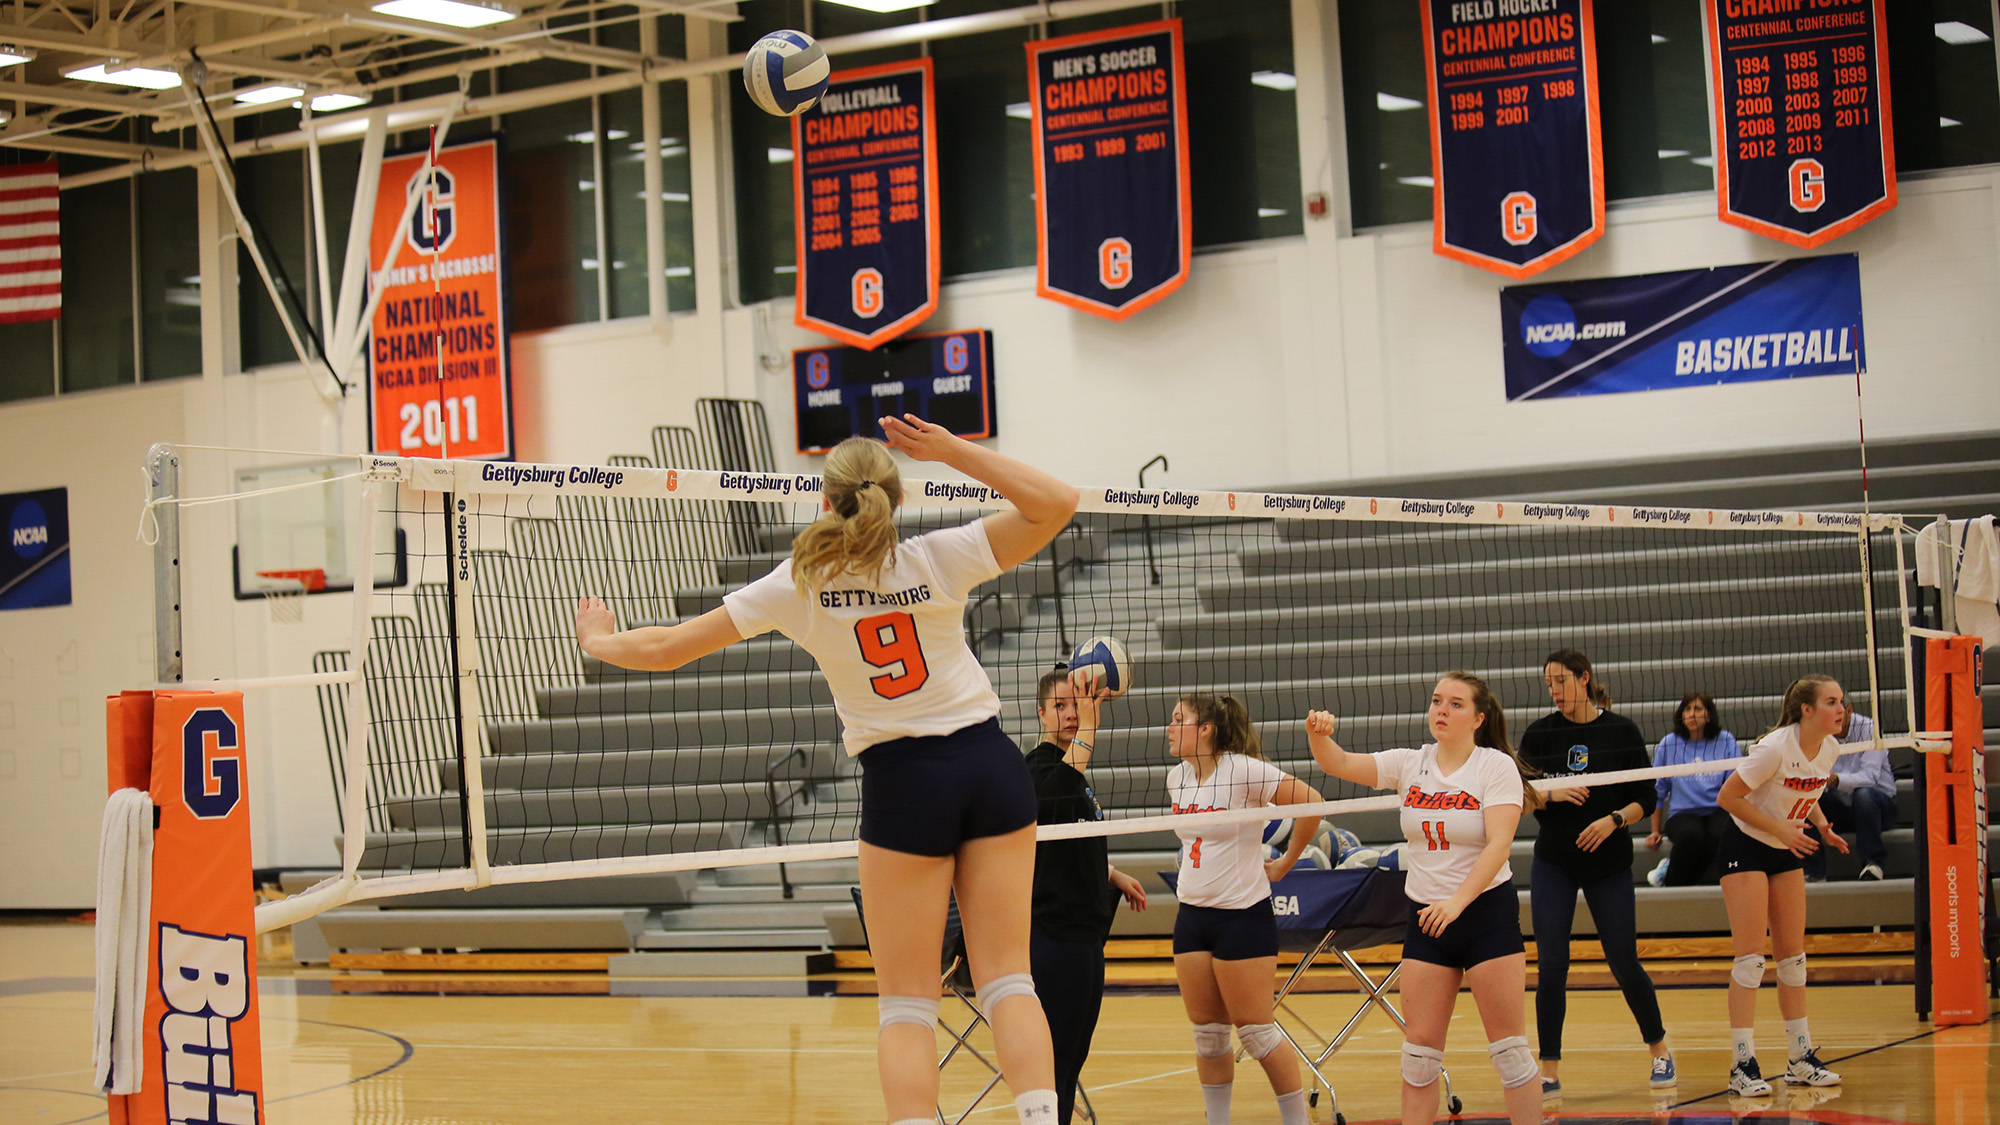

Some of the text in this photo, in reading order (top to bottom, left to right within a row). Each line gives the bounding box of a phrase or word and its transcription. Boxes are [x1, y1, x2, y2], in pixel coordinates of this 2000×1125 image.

[1451, 0, 1494, 23] FIELD
[1725, 0, 1863, 18] CHAMP
[1441, 13, 1574, 56] CHAMPIONS
[1727, 11, 1866, 40] CENTENNIAL CONFERENCE
[1053, 46, 1157, 79] MEN'S SOCCER
[1443, 46, 1576, 76] CENTENNIAL CONFERENCE
[1735, 45, 1866, 75] 1994 1995 1996
[1045, 68, 1167, 110] CHAMPIONS
[1450, 79, 1575, 111] 1994 1997 1998
[1736, 65, 1867, 96] 1997 1998 1999
[820, 84, 902, 115] VOLLEYBALL
[1736, 86, 1868, 117] 2000 2003 2007
[805, 105, 919, 145] CHAMPIONS
[1046, 100, 1168, 130] CENTENNIAL CONFERENCE
[1451, 105, 1530, 131] 1999 2001
[1738, 108, 1869, 138] 2008 2009 2011
[1136, 131, 1167, 152] 2001
[1739, 135, 1823, 160] 2012 2013
[1788, 158, 1826, 213] G
[406, 165, 455, 256] G
[1500, 190, 1538, 246] G
[1098, 236, 1133, 290] G
[852, 266, 884, 319] G
[386, 290, 485, 328] NATIONAL
[376, 323, 496, 363] CHAMPIONS
[1526, 320, 1626, 345] NCAA.com
[943, 335, 969, 374] G
[1675, 327, 1853, 376] BASKETBALL
[376, 369, 415, 389] NCAA
[419, 359, 480, 385] DIVSION
[806, 352, 830, 389] G
[932, 375, 973, 395] GUEST
[807, 389, 842, 408] HOME
[871, 381, 904, 397] PERIOD
[400, 394, 479, 450] 2011
[482, 463, 624, 489] Gettysburg College
[666, 469, 678, 491] G
[720, 472, 824, 496] Gettysburg Coll
[924, 481, 988, 503] Gettysburg
[1104, 488, 1200, 509] Gettysburg College
[1228, 493, 1236, 511] G
[1264, 495, 1346, 514] Gettysburg College
[1401, 500, 1475, 518] Gettysburg College
[1523, 504, 1590, 521] Gettysburg College
[1633, 508, 1667, 523] Gettysburg
[13, 526, 48, 546] NCAA
[458, 515, 469, 581] Schelde
[820, 584, 931, 608] GETTYSBURG
[853, 610, 930, 700] 9
[181, 706, 242, 820] G
[1404, 785, 1481, 810] Bullets
[1787, 798, 1817, 819] 16
[1422, 821, 1450, 850] 11
[1189, 837, 1203, 868] 4
[1270, 895, 1300, 916] SA
[1946, 866, 1960, 958] sports imports
[158, 921, 259, 1125] Bul
